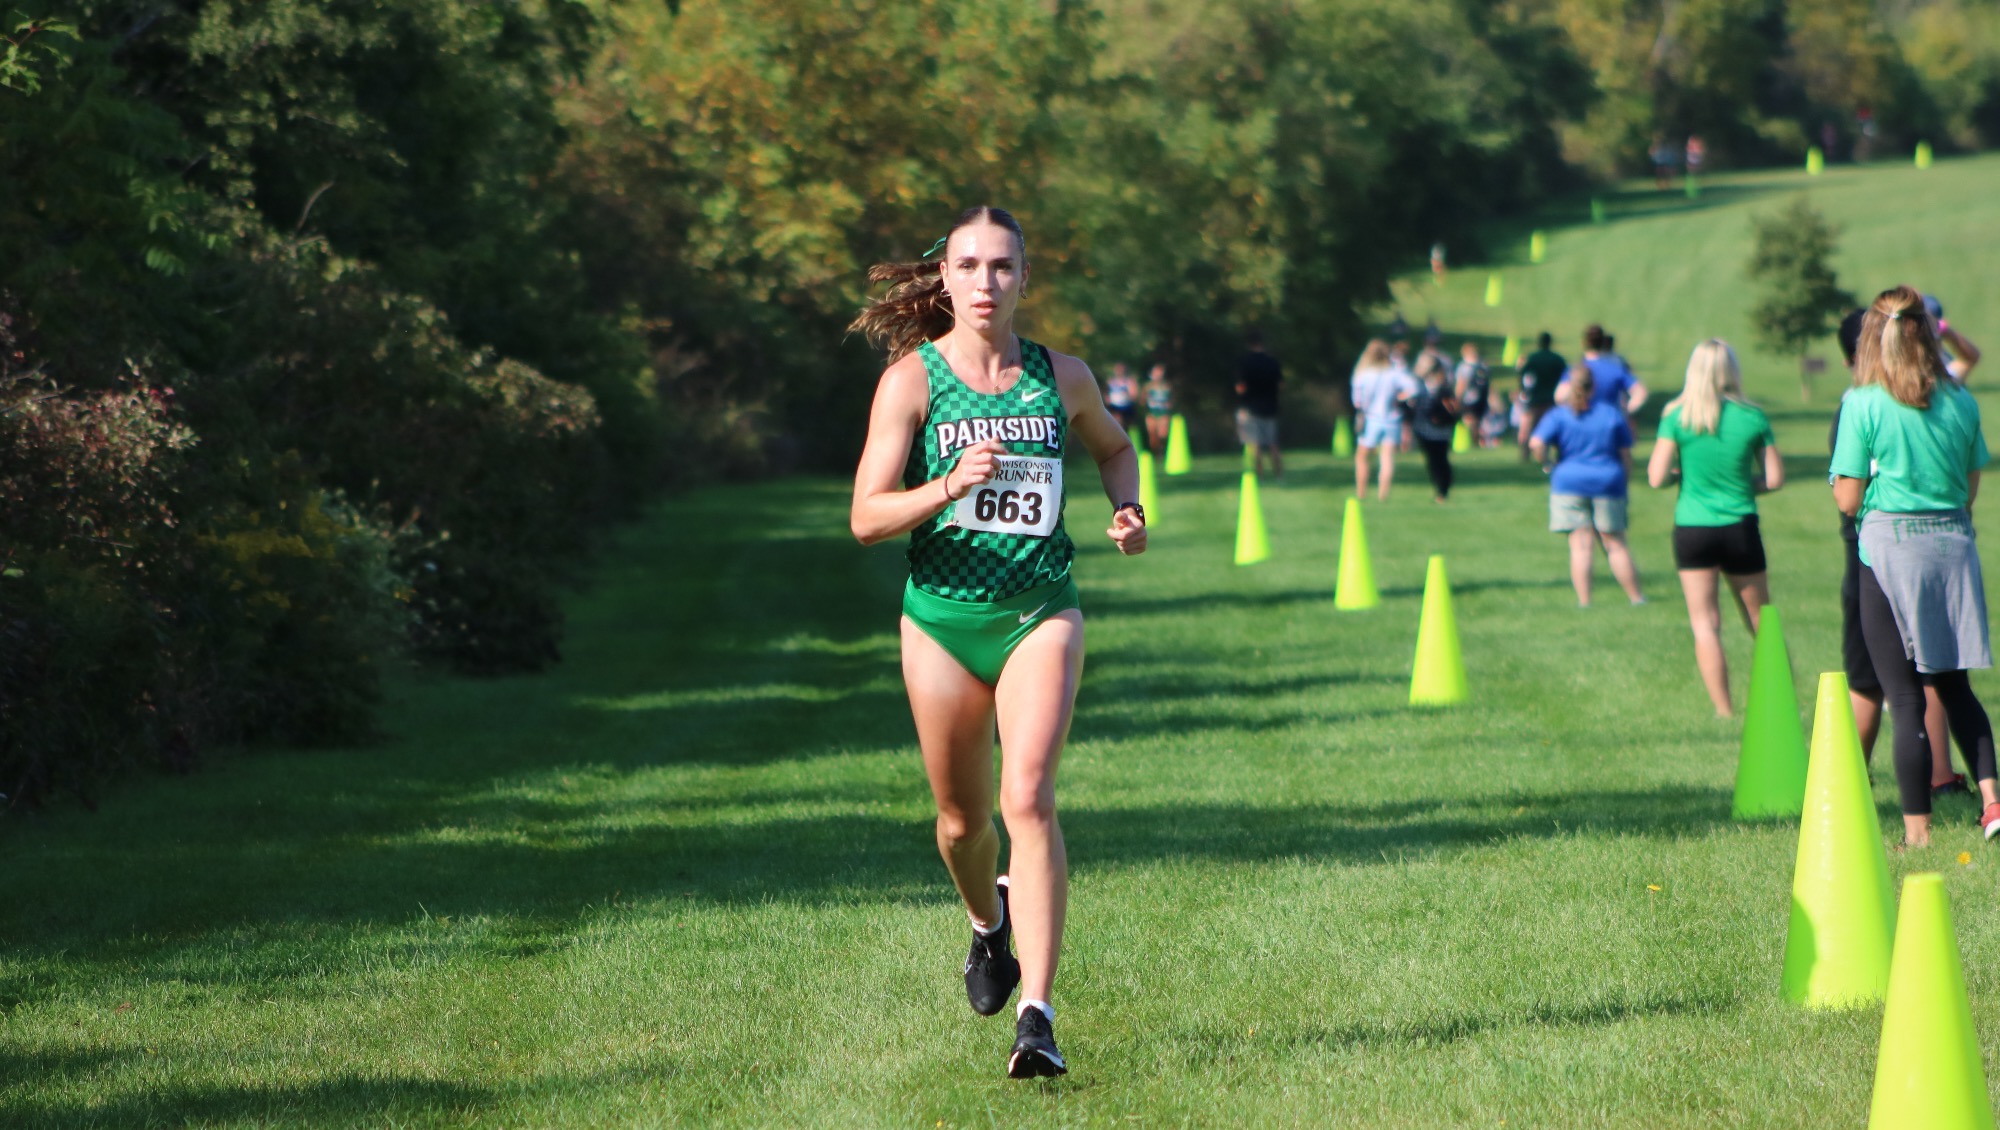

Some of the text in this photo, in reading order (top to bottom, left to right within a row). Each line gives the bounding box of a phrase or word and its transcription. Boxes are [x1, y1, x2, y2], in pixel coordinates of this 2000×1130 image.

[937, 416, 1060, 459] PARKSIDE
[994, 469, 1053, 484] RUNNER
[1001, 460, 1053, 470] WISCONSIN
[975, 488, 1042, 526] 663
